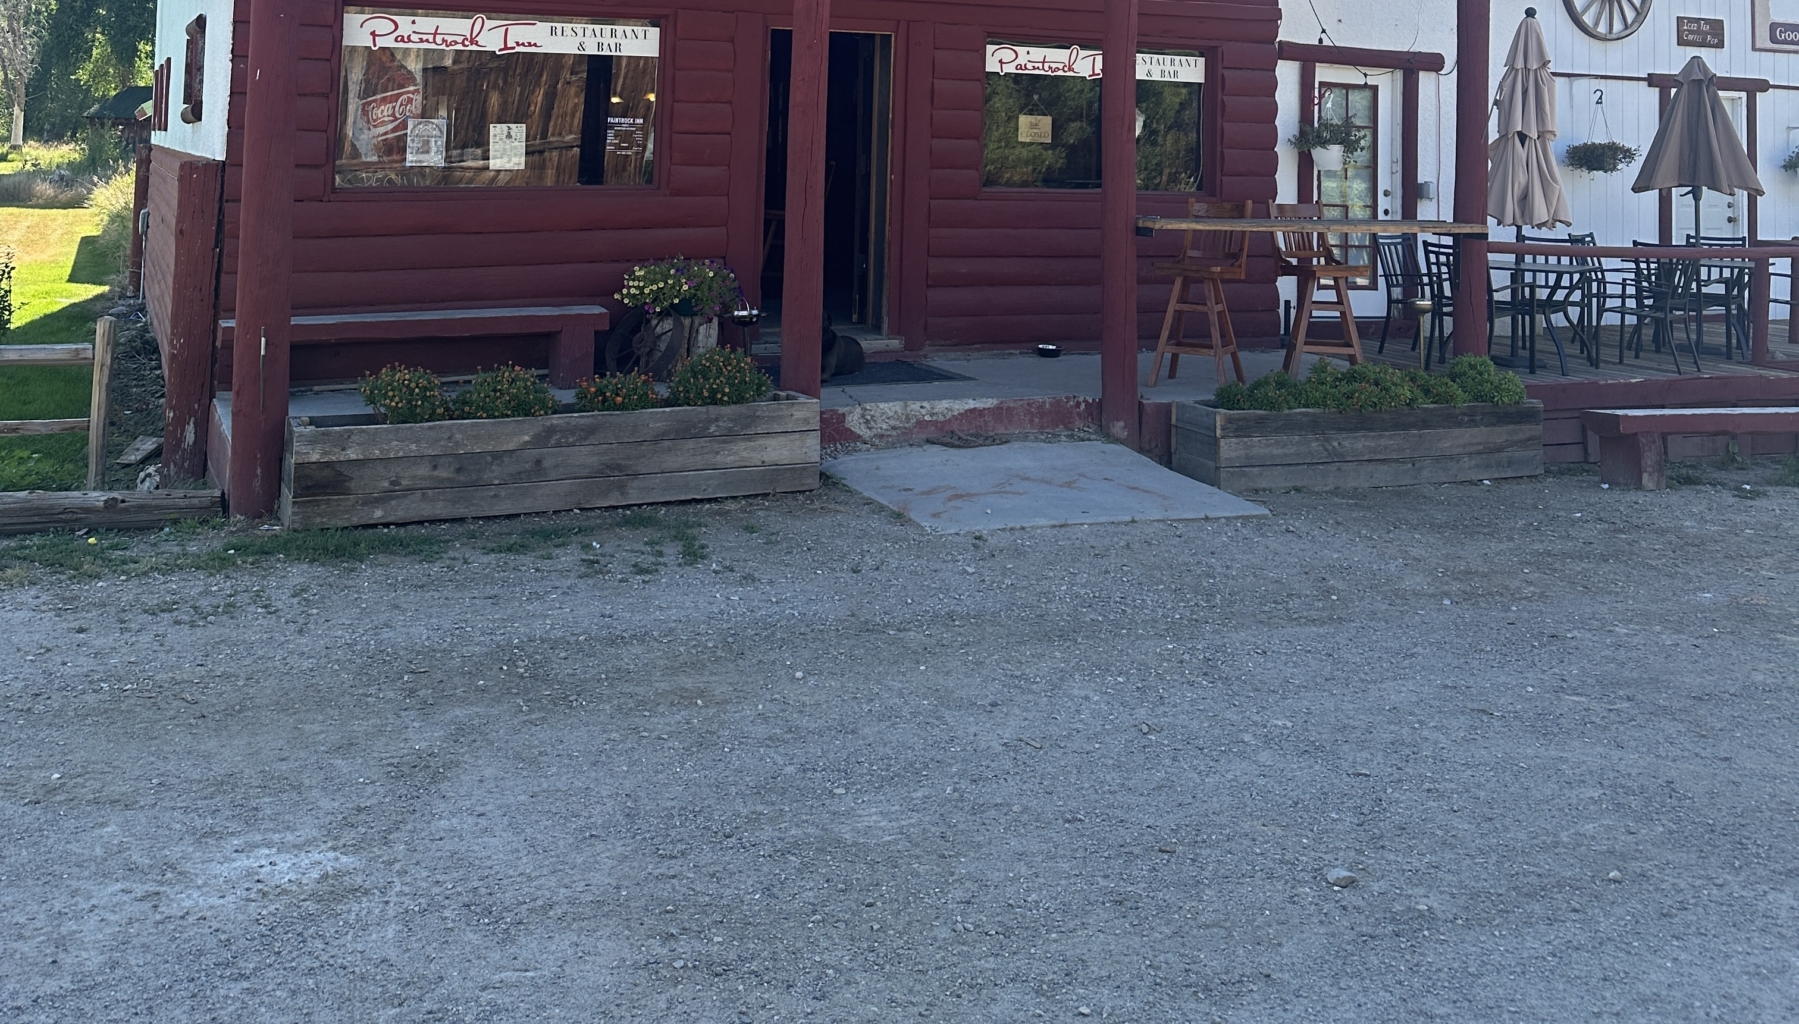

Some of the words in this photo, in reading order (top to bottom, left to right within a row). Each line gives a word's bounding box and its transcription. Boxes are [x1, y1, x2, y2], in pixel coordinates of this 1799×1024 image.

[359, 15, 487, 48] Paintrock
[487, 22, 543, 52] Inn
[550, 25, 650, 40] RESTAURANT
[577, 40, 587, 53] &
[597, 41, 623, 54] BAR
[991, 46, 1081, 74] Paintrock
[1145, 69, 1154, 79] &
[1160, 69, 1179, 80] BAR
[1020, 130, 1050, 139] CLOSED
